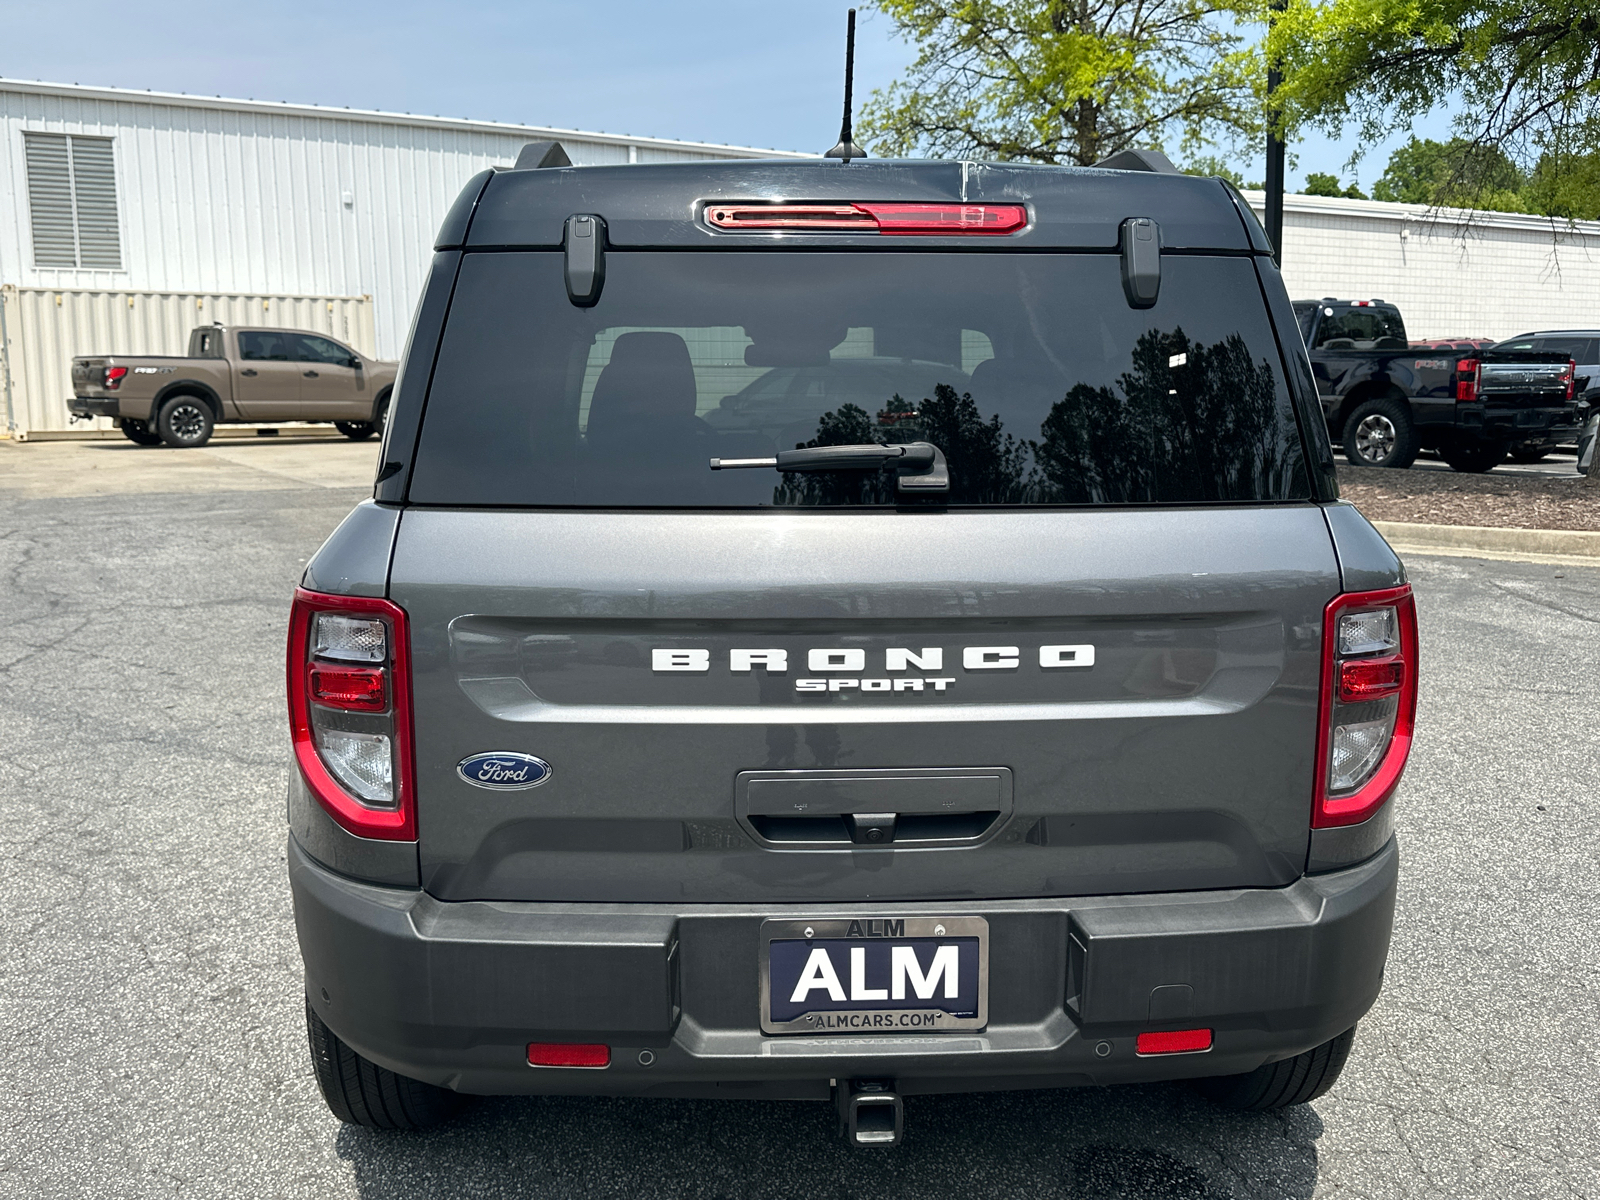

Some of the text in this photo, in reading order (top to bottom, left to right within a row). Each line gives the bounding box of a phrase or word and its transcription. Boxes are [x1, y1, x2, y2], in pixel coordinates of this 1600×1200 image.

[651, 645, 1096, 672] BRONCO
[795, 678, 956, 692] SPORT
[478, 760, 528, 781] Ford
[846, 919, 905, 937] ALM
[789, 945, 959, 1003] ALM
[815, 1014, 935, 1028] ALMCARS.COM
